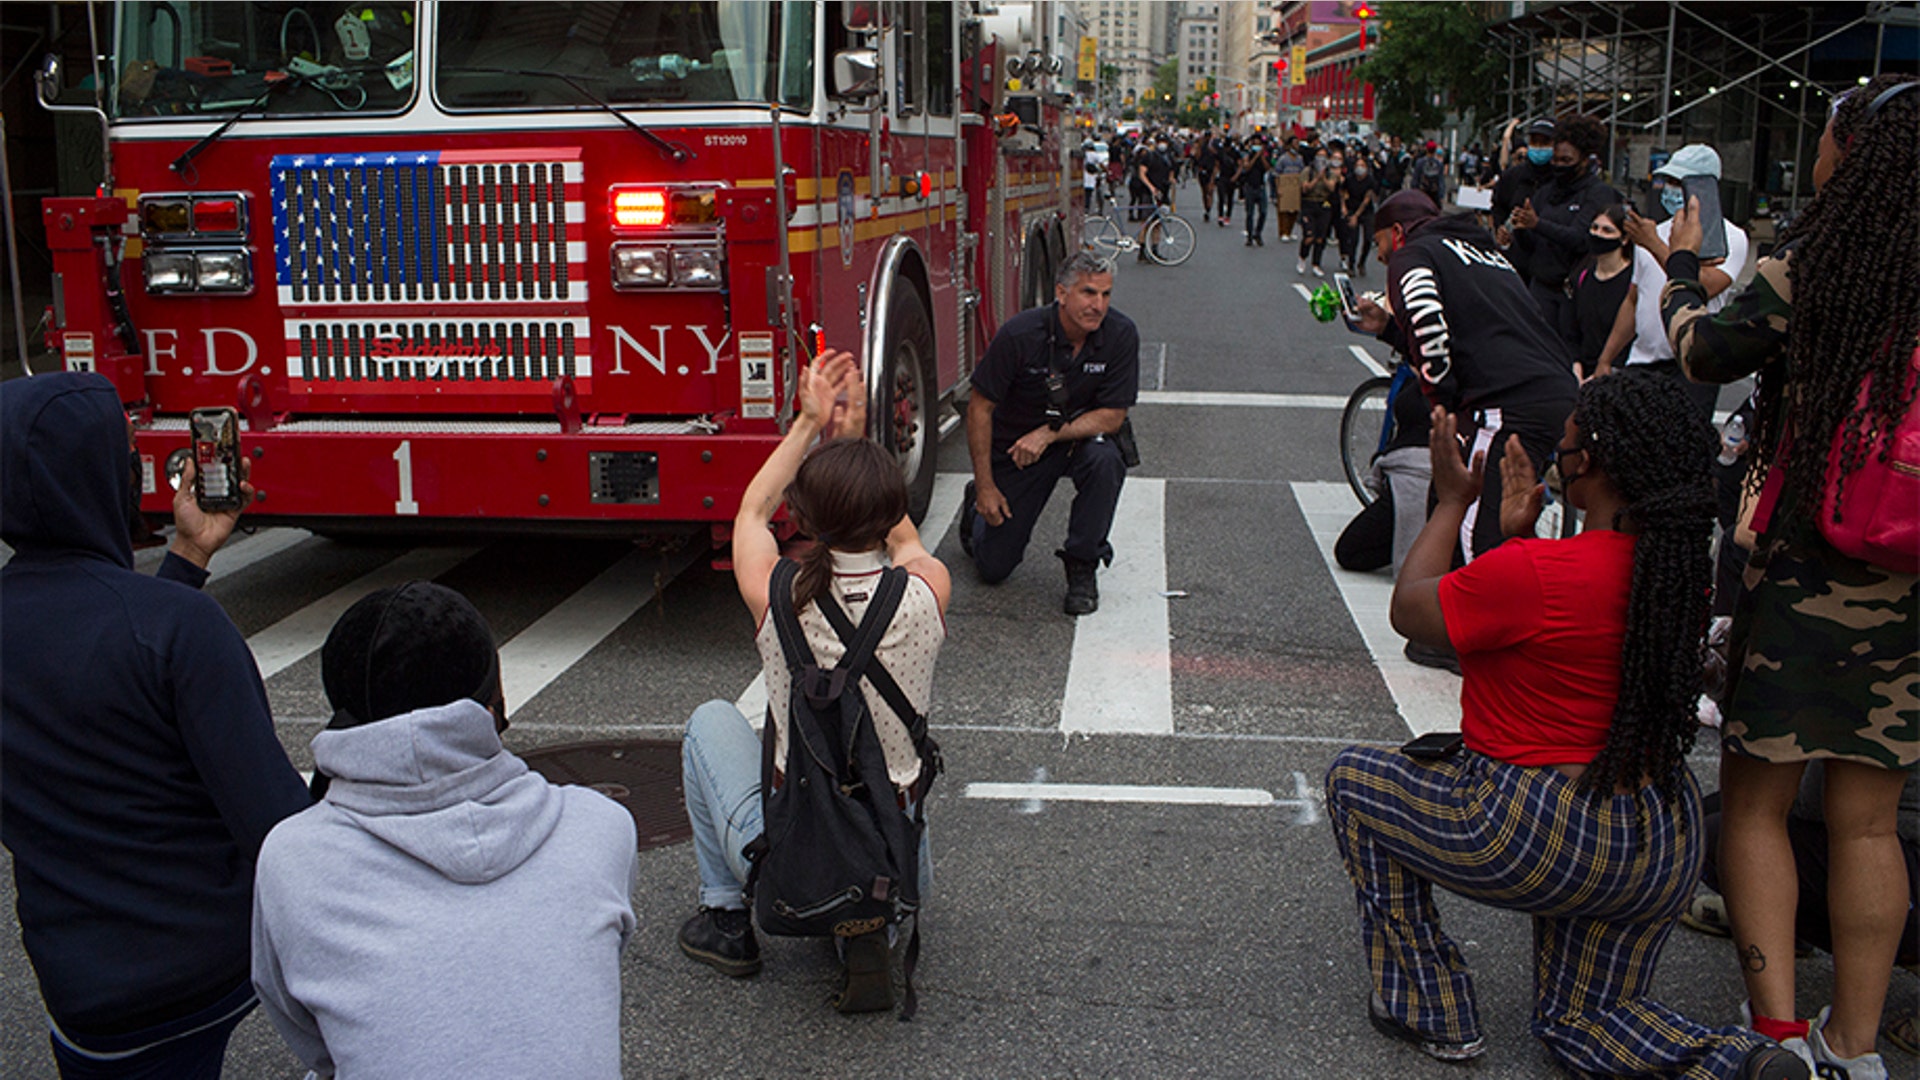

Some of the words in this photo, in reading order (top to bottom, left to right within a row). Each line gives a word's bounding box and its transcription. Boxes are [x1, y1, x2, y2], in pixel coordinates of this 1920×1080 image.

[704, 134, 748, 146] ST12010
[140, 327, 272, 377] F.D.
[1400, 266, 1452, 385] CALVIN
[392, 440, 419, 515] 1
